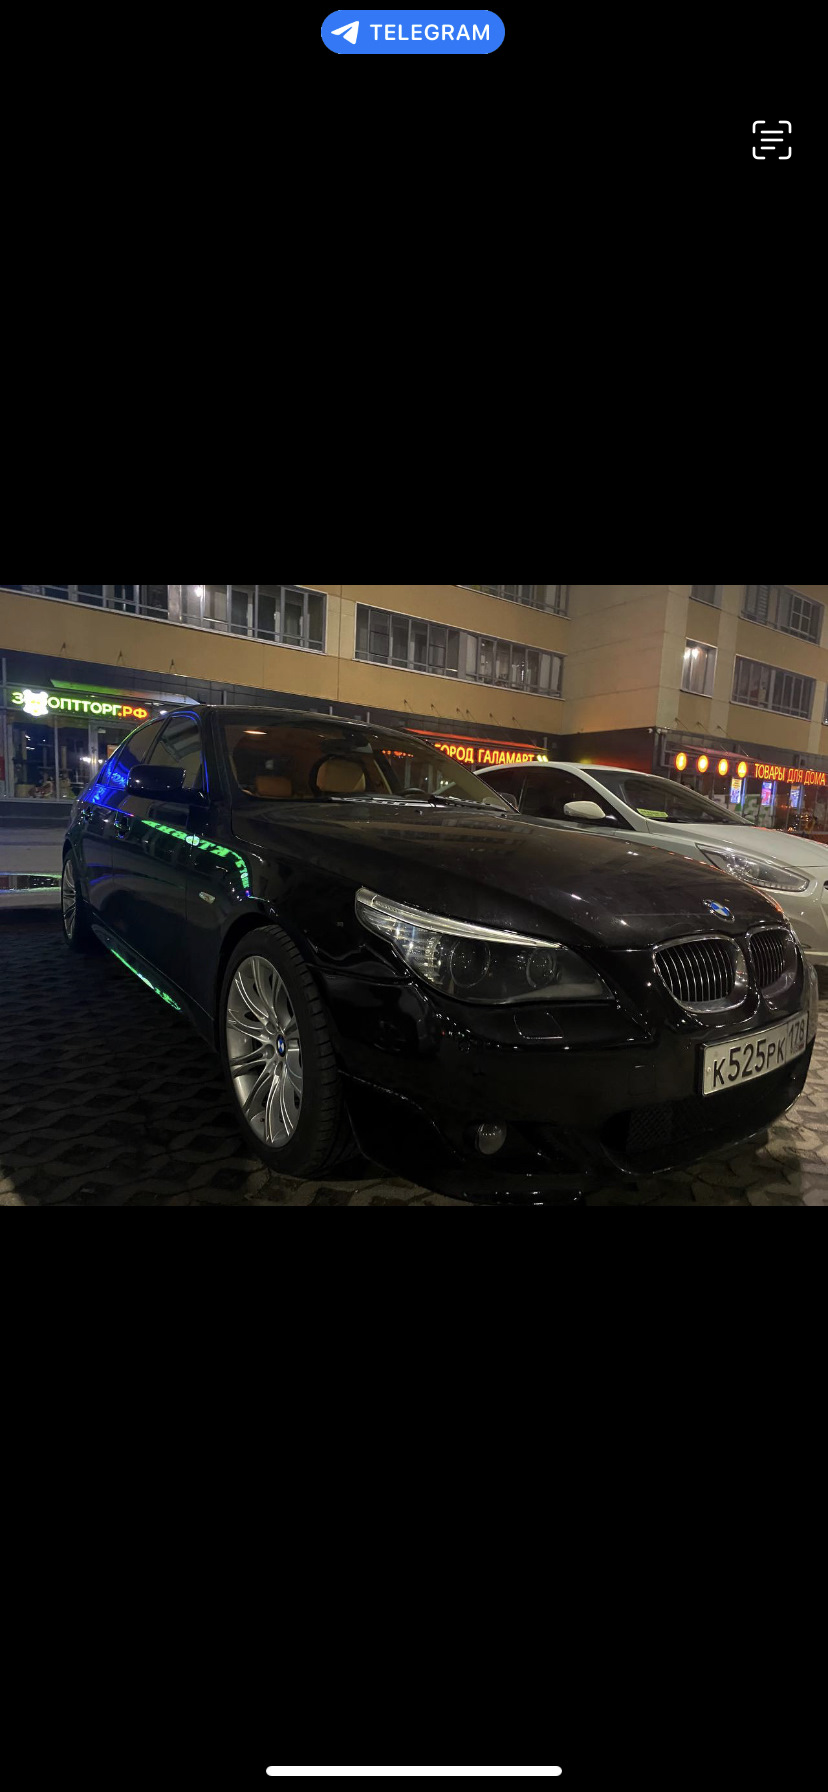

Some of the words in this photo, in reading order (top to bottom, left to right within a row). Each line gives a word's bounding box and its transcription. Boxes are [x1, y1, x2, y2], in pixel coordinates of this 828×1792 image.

[478, 749, 535, 765] ГАЛАМАРТ
[754, 763, 785, 781] ТОВАРЫ
[787, 768, 803, 784] ДЛЯ
[804, 770, 826, 786] ДОМА
[789, 1019, 805, 1049] 178
